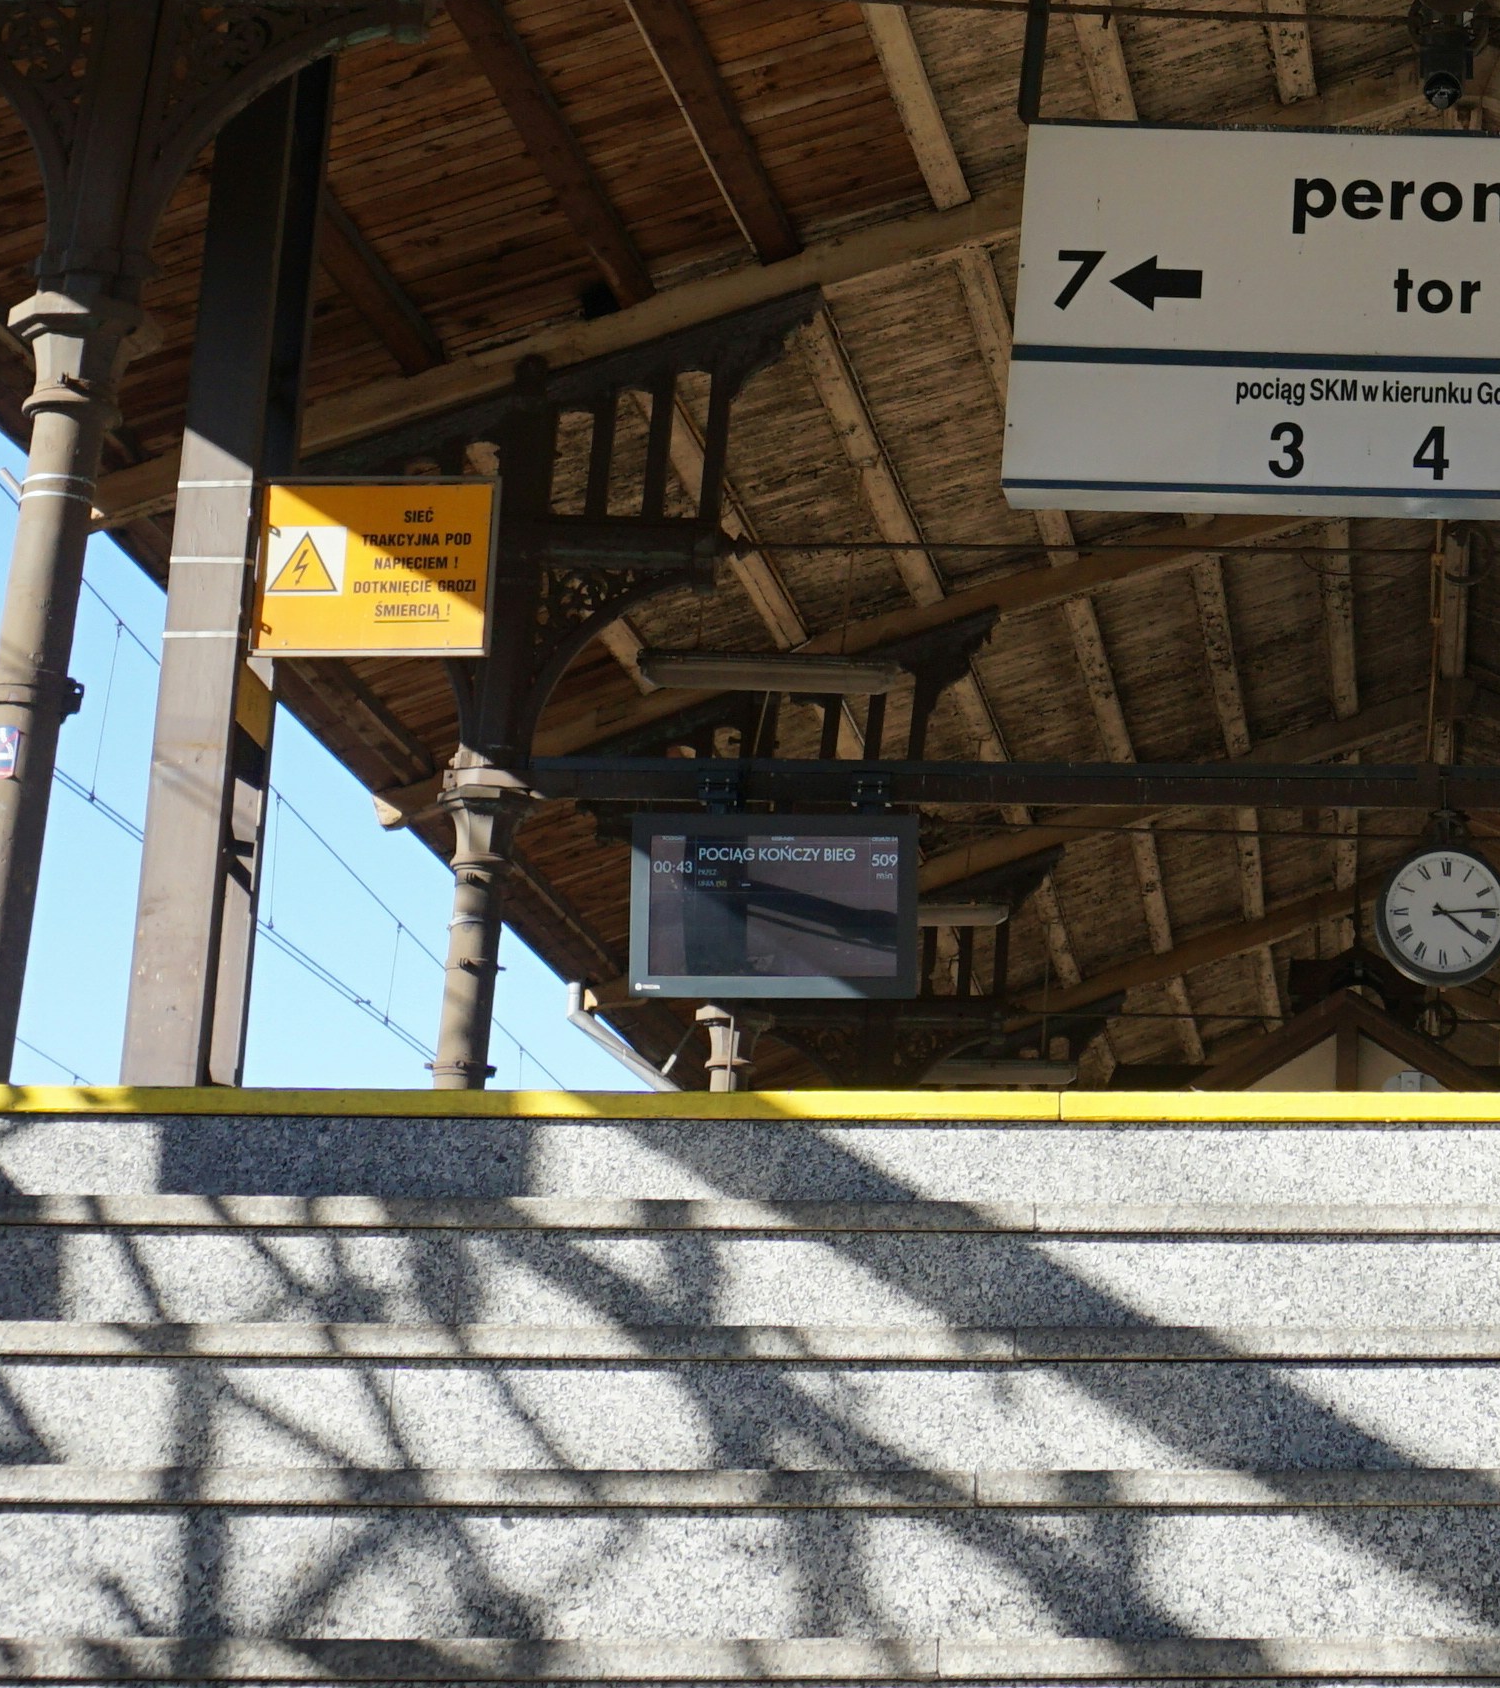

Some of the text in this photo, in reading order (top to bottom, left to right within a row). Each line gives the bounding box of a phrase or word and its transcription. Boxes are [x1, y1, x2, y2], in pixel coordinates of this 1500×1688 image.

[1053, 249, 1107, 311] 7
[1393, 268, 1481, 314] tor
[1236, 378, 1305, 406] pociąg
[1310, 378, 1357, 402] SKM
[1362, 385, 1378, 402] w
[1383, 380, 1472, 404] kierunku
[1267, 422, 1305, 480] 3
[1412, 425, 1451, 482] 4
[404, 506, 434, 523] SIEĆ
[362, 532, 471, 547] TRAKCYJNA POD
[374, 557, 448, 572] NAPIĘCIEM
[353, 579, 476, 596] DOTKNIĘCIE GROZI
[375, 600, 440, 620] ŚMIERCIĄ
[698, 845, 856, 863] POCIĄG KOŃCZY BIEG
[871, 854, 898, 867] 509
[653, 860, 693, 873] 00:43
[876, 870, 894, 880] min
